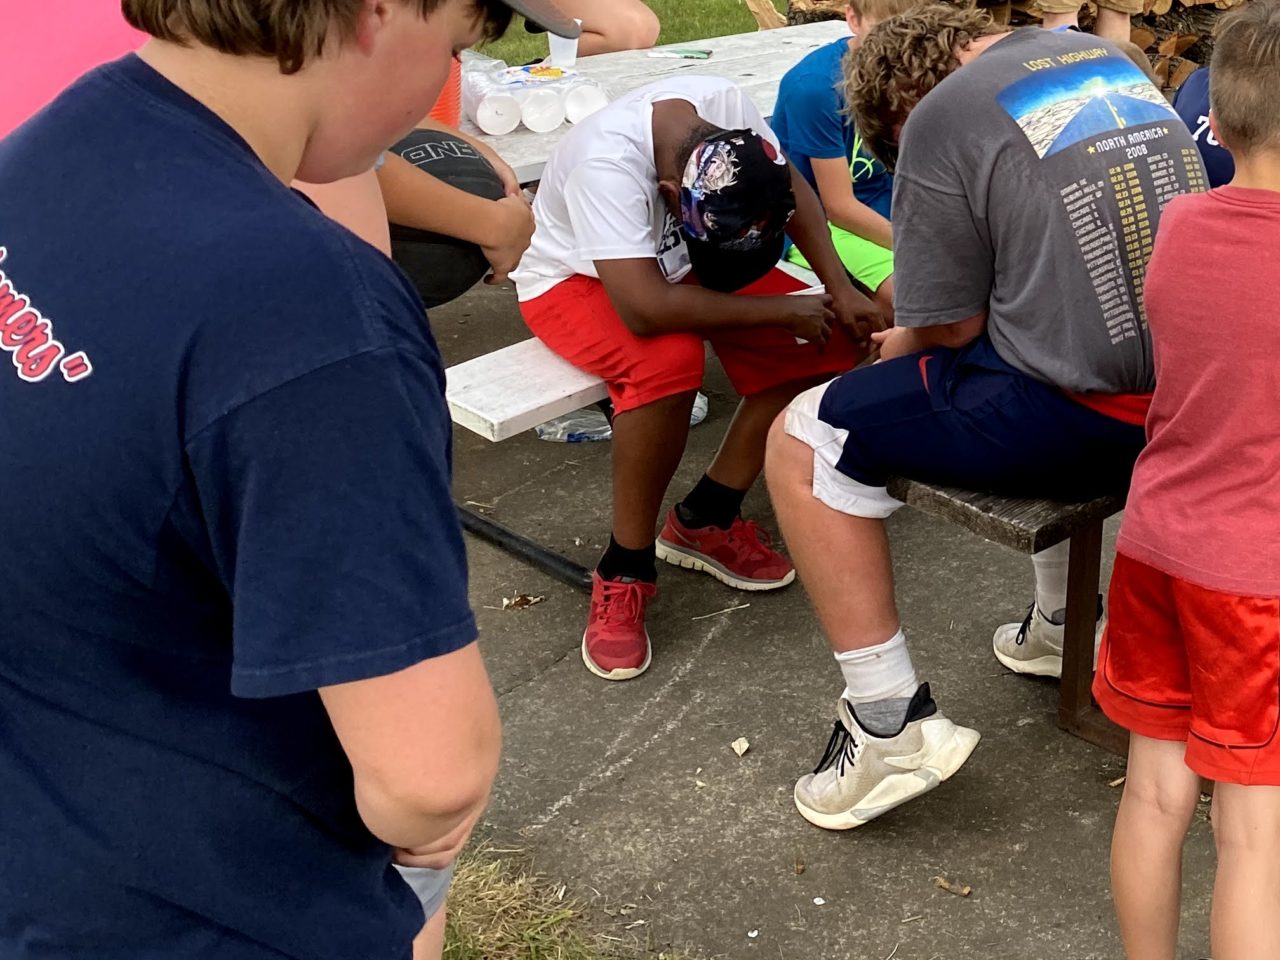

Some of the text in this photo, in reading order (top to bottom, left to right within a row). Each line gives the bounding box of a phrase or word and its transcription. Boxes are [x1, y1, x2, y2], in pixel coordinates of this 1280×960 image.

[1023, 47, 1109, 72] LOST HIGHWAY
[1095, 127, 1164, 153] NORTH AMERICA
[1126, 144, 1148, 160] 2008
